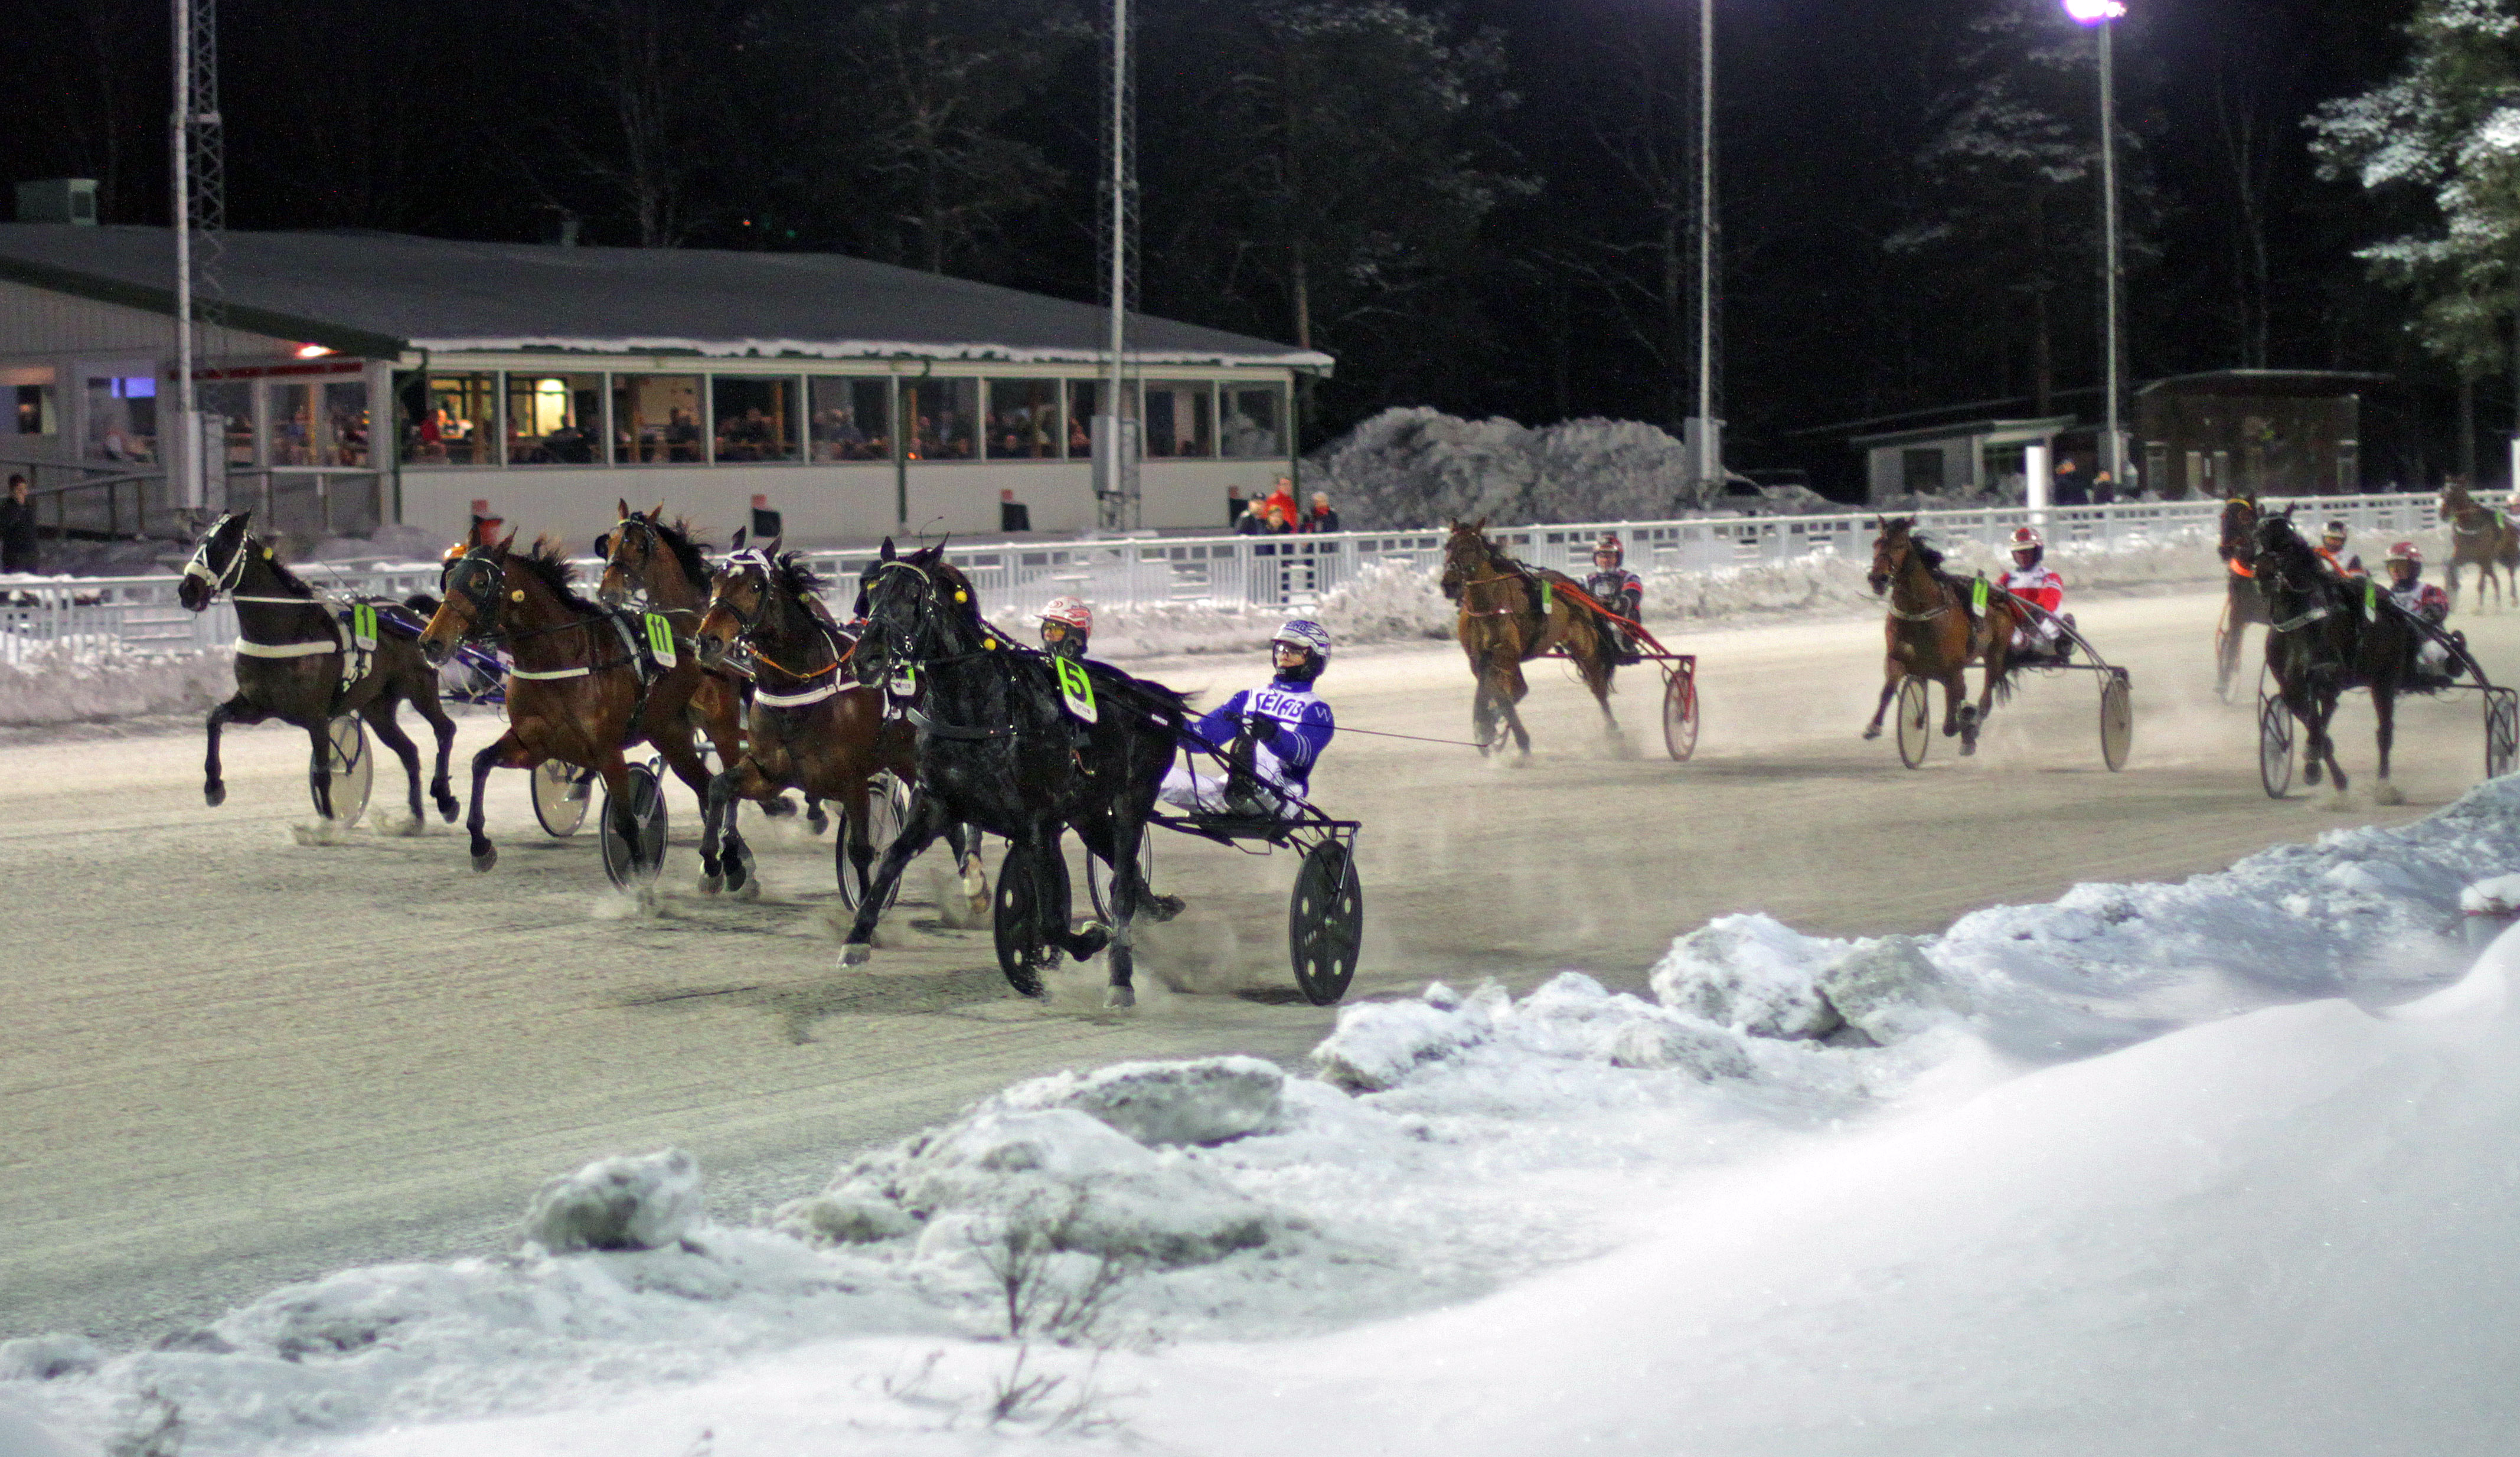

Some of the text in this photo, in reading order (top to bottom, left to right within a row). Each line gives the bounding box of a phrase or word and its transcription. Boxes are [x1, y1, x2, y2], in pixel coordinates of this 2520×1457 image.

[362, 606, 368, 636] 1
[651, 616, 668, 652] 11
[1063, 661, 1087, 702] 5
